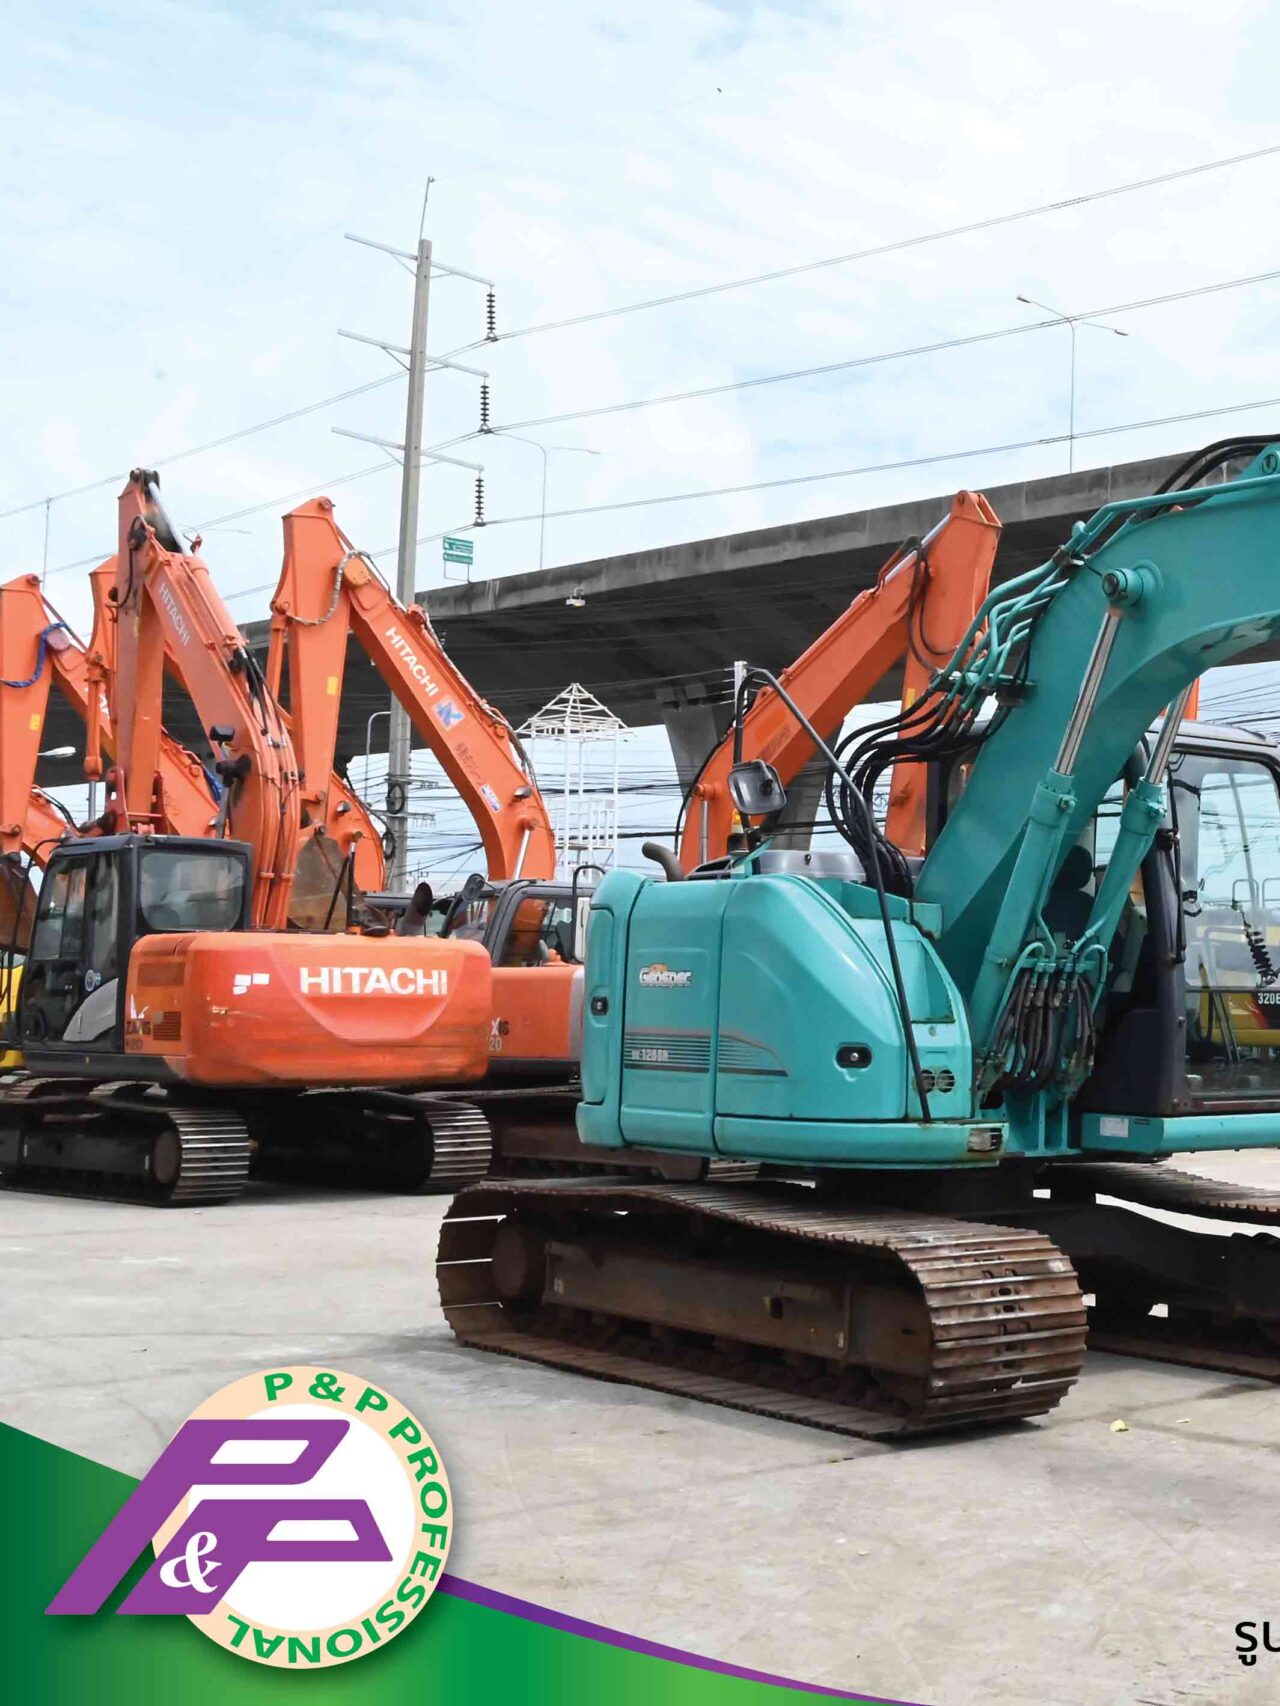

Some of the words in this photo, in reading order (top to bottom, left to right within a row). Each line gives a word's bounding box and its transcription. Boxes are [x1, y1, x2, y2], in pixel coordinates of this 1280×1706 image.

[160, 582, 190, 647] HITACHI
[385, 627, 440, 697] HITACHI
[299, 967, 448, 995] HITACHI
